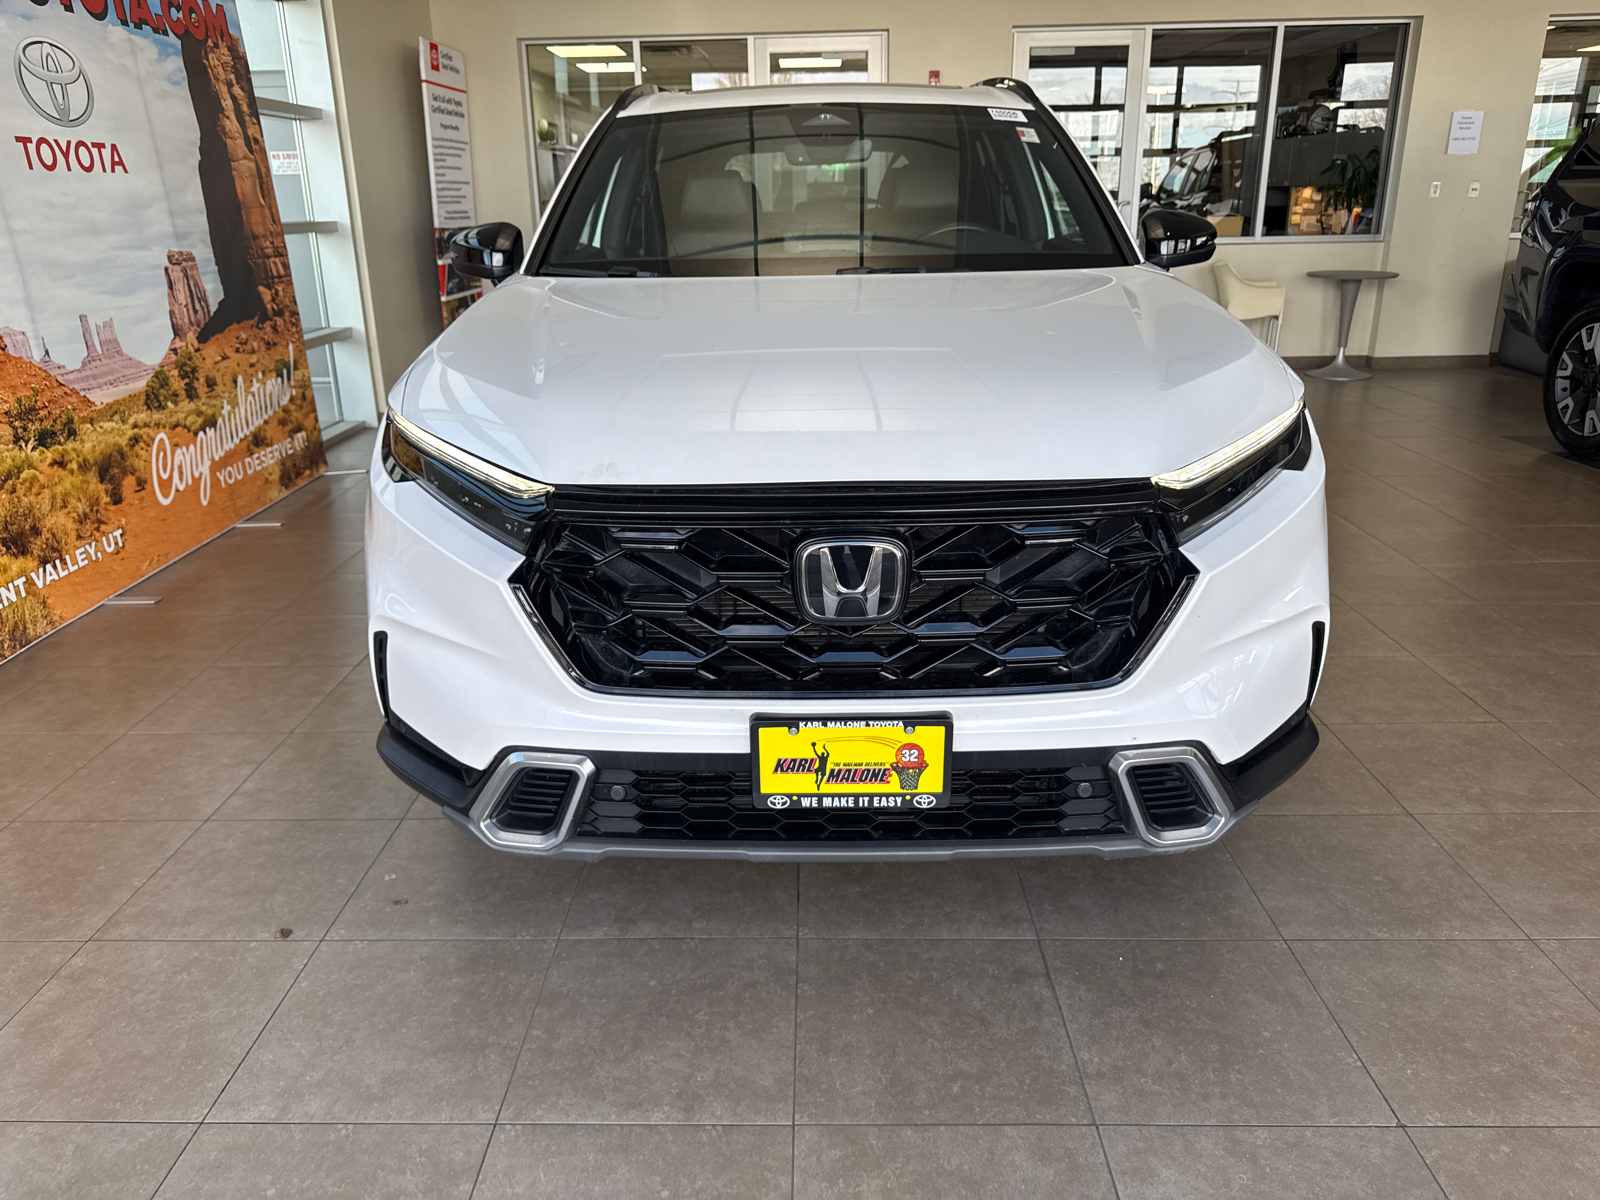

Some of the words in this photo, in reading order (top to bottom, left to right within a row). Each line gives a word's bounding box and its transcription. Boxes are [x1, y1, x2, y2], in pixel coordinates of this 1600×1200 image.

[14, 135, 129, 174] TOYOTA
[152, 342, 296, 506] Congratulations!
[216, 461, 243, 488] YOU
[244, 440, 294, 475] DESERVE
[0, 575, 27, 610] NT
[29, 541, 102, 589] VALLEY,
[101, 528, 123, 553] UT
[799, 721, 824, 729] KARL
[827, 721, 866, 729] MALONE
[868, 720, 904, 728] TOYOTA
[901, 749, 919, 762] 32
[773, 757, 817, 774] KARL
[825, 768, 891, 784] MALONE
[800, 796, 818, 807] WE
[822, 796, 855, 807] MAKE
[859, 796, 870, 807] IT
[873, 796, 902, 807] EASY
